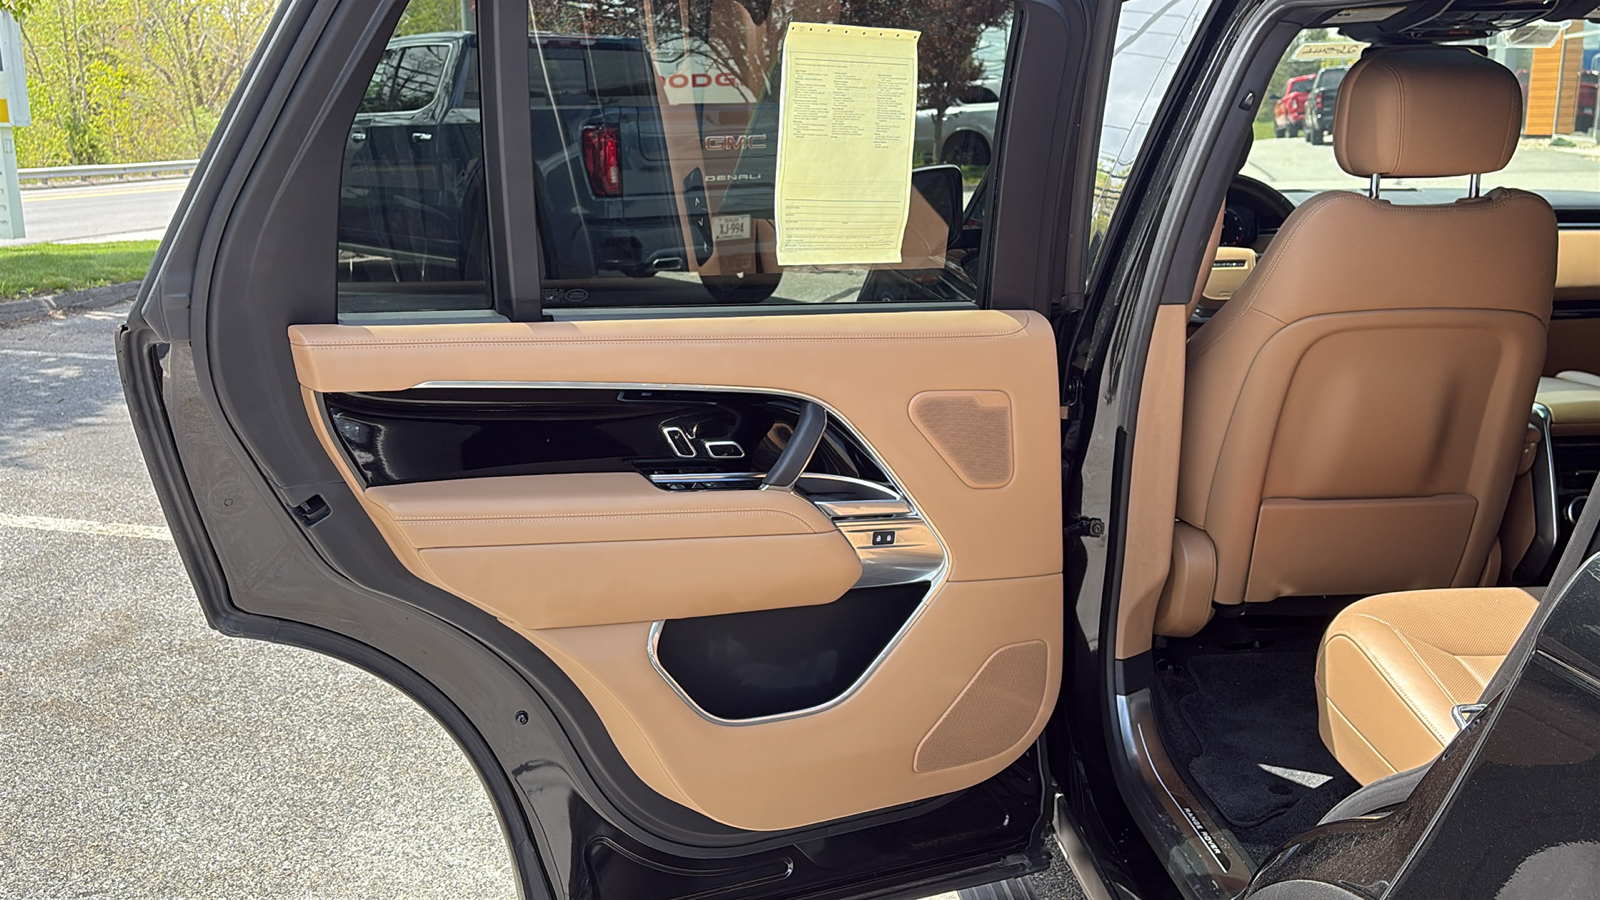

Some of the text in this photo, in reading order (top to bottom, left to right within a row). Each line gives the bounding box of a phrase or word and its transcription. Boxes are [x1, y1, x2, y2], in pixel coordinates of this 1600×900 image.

[659, 72, 744, 89] ODG
[705, 133, 767, 151] GMC
[705, 173, 761, 182] DENALI
[719, 222, 744, 235] XJ-994
[1184, 807, 1222, 854] RANGE ROVER
